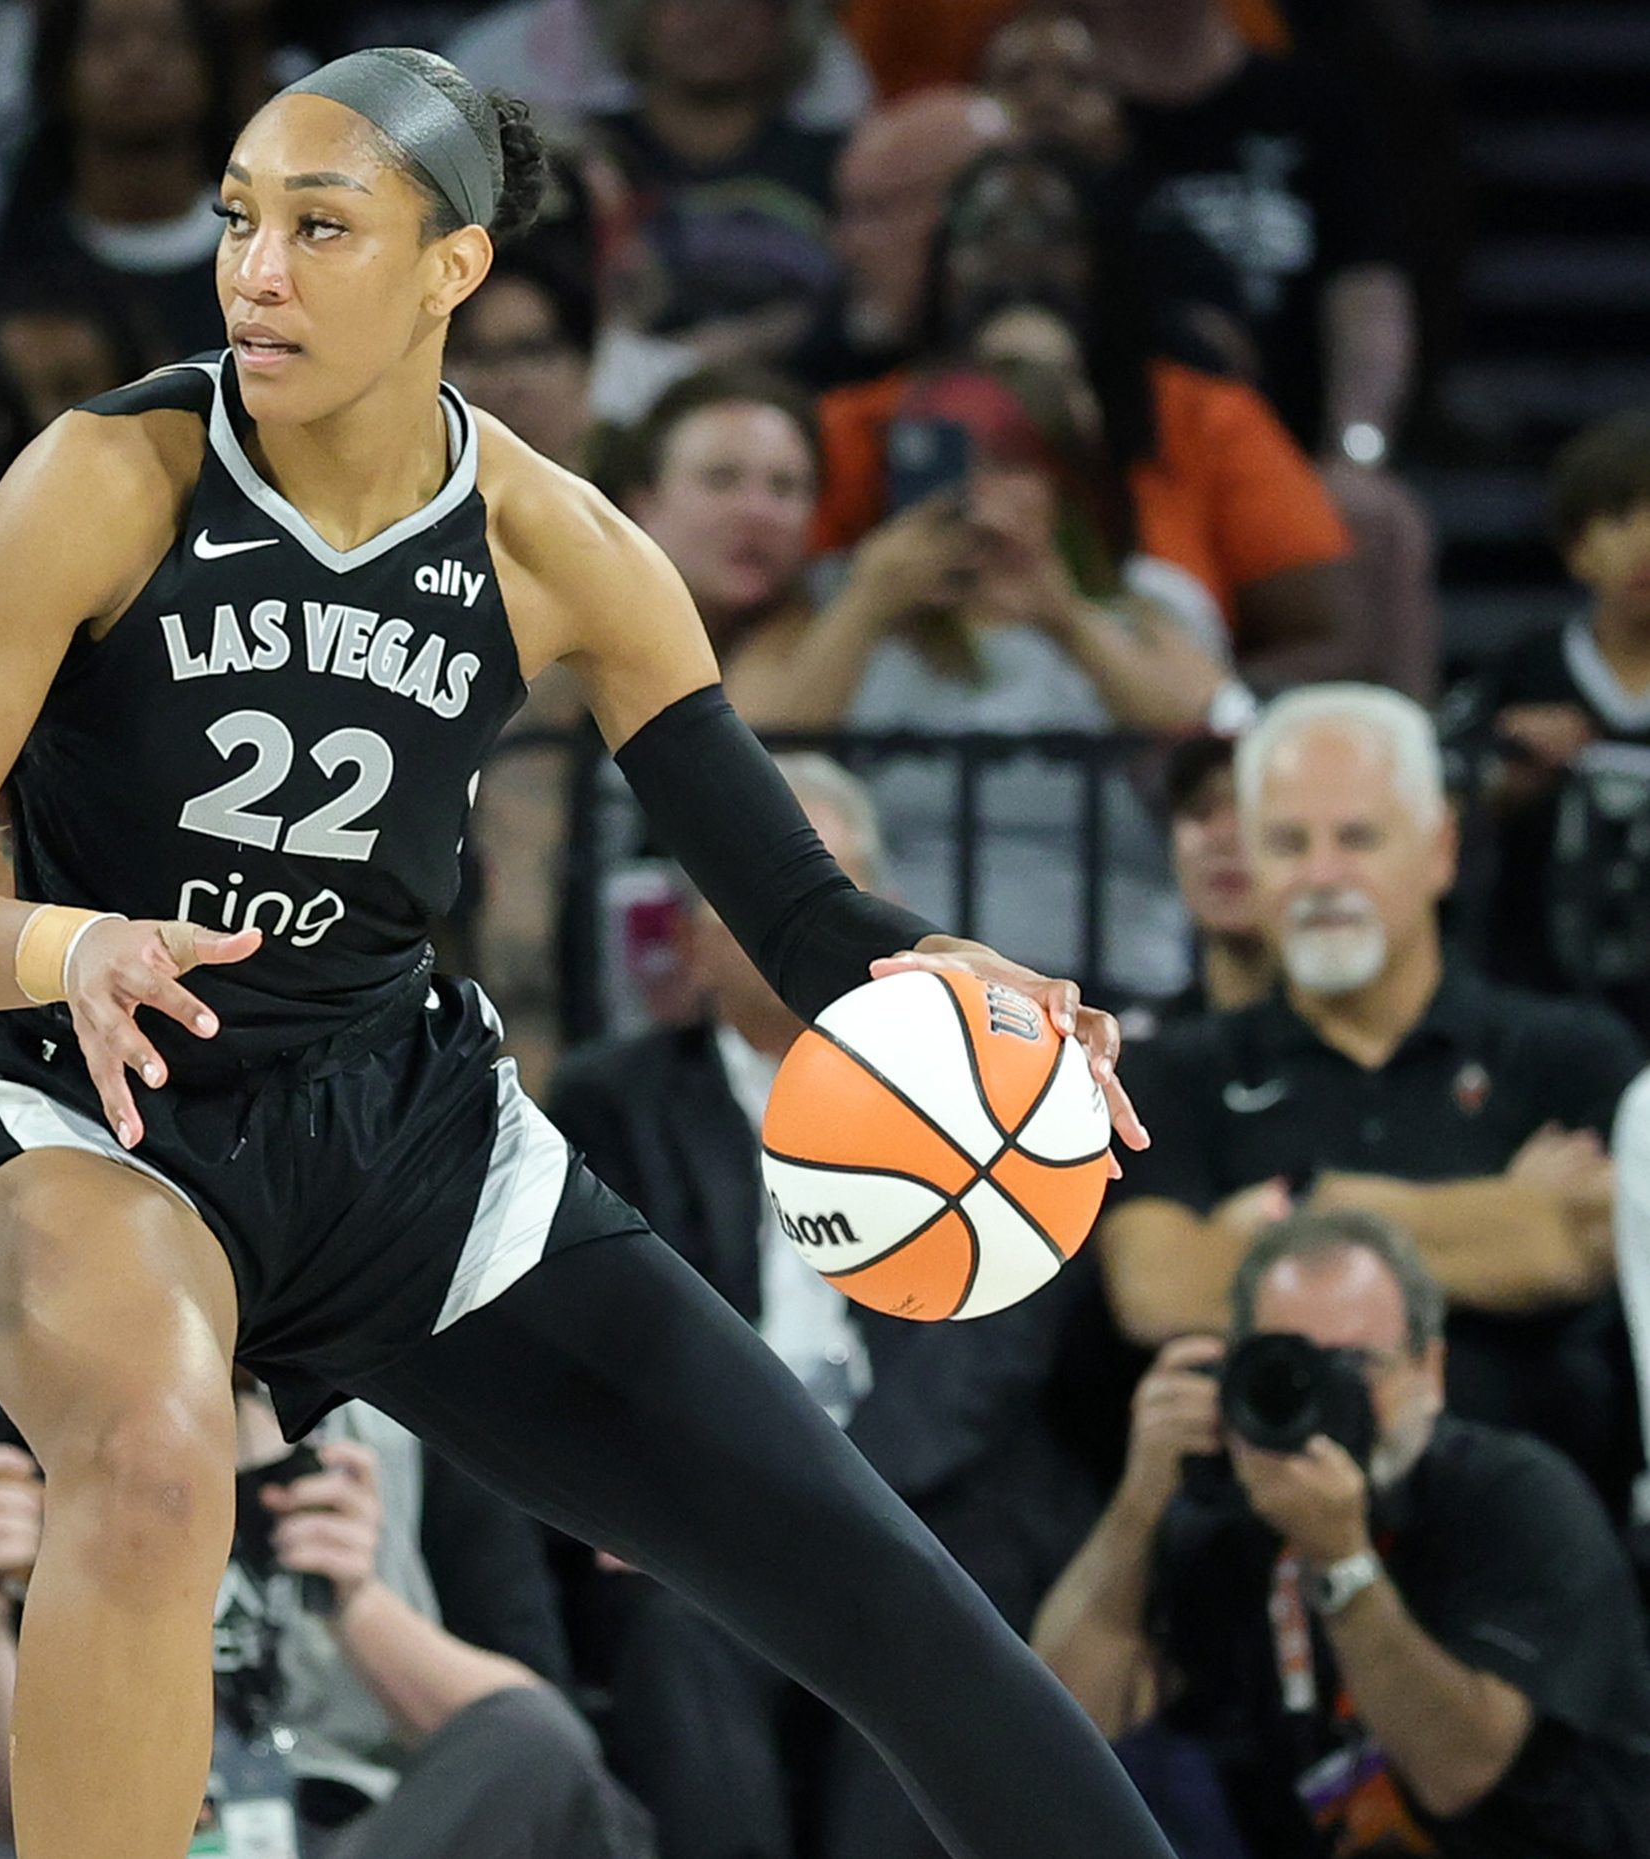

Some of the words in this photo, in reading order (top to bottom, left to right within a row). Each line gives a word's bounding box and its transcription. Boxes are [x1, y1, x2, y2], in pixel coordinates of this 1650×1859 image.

[414, 559, 486, 607] ally
[159, 600, 291, 681] LAS
[302, 601, 481, 719] VEGAS
[178, 709, 394, 861] 22
[178, 872, 345, 947] ring
